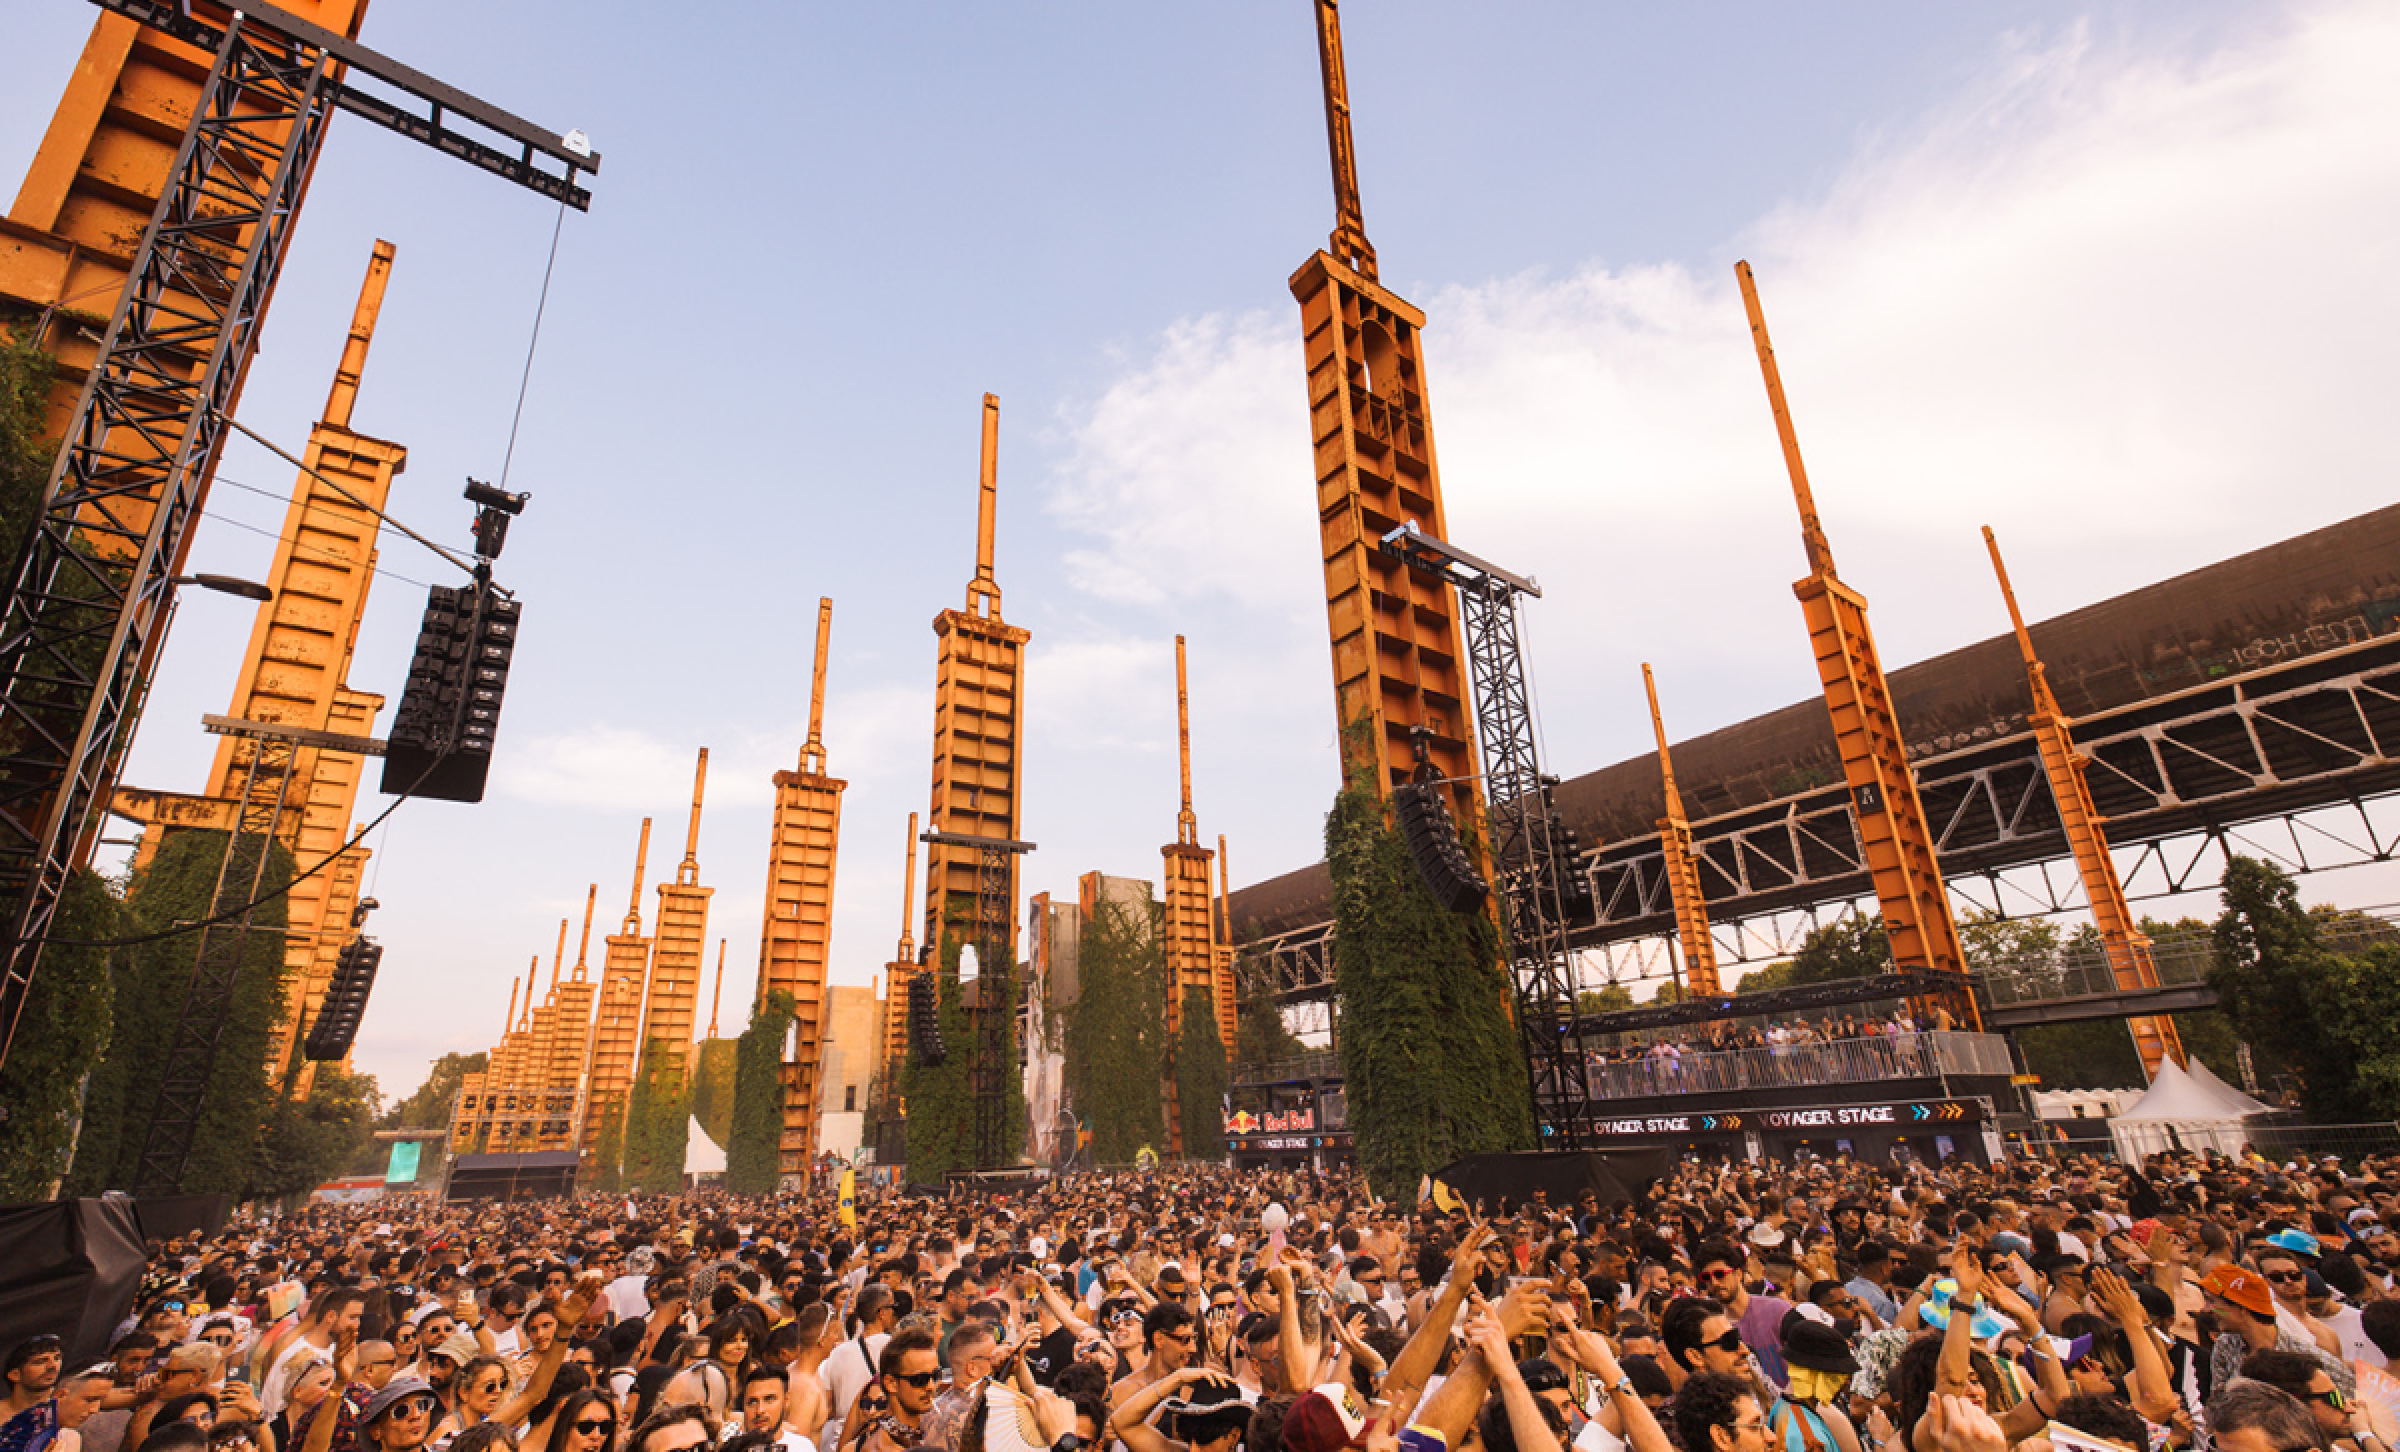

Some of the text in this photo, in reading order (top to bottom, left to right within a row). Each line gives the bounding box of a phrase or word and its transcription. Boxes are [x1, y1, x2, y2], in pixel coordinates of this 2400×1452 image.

[1265, 1108, 1315, 1132] Red Bull
[1646, 1117, 1690, 1131] STAGE
[1758, 1106, 1896, 1127] VOYAGER STAGE
